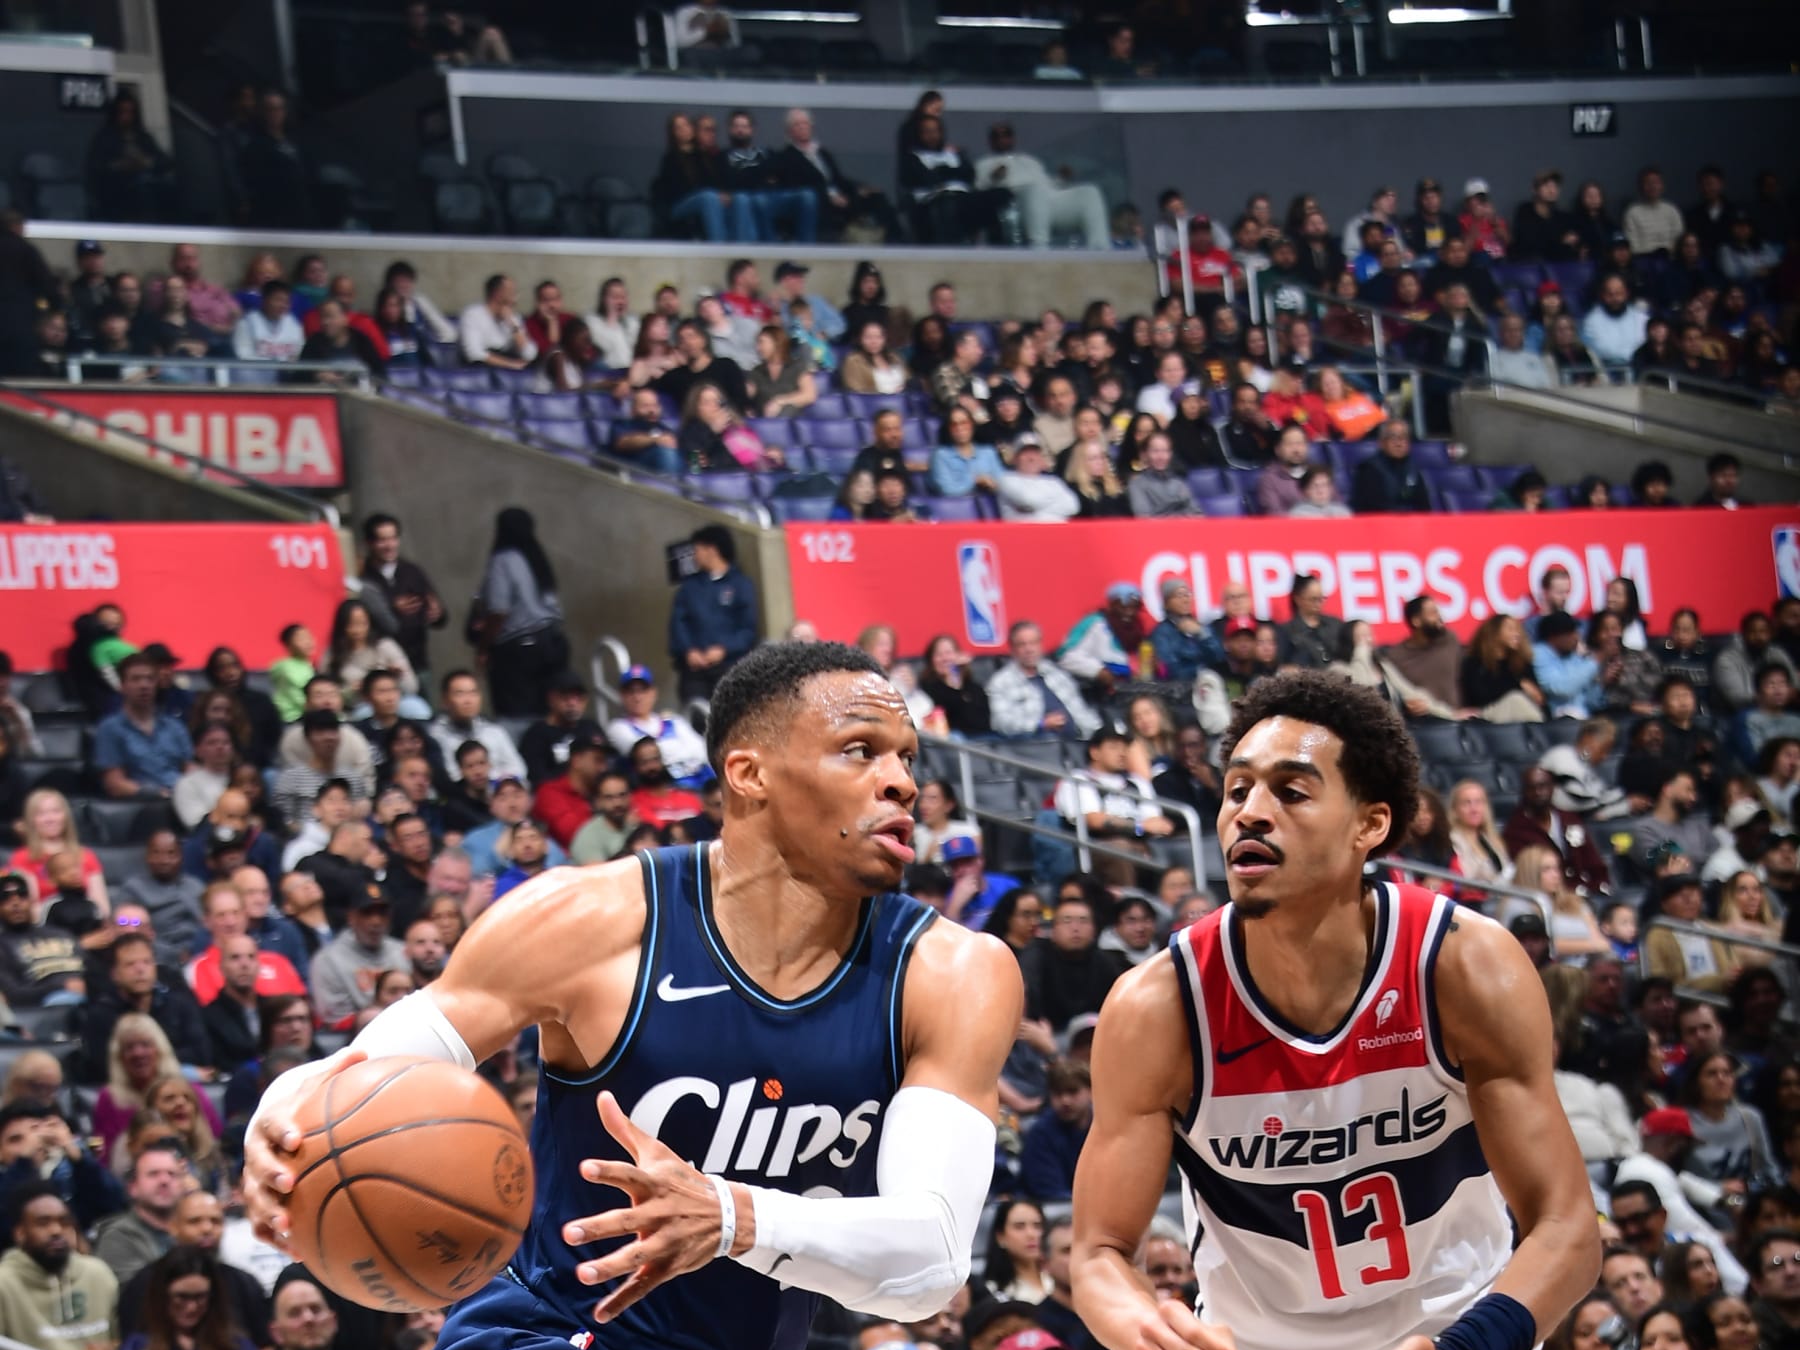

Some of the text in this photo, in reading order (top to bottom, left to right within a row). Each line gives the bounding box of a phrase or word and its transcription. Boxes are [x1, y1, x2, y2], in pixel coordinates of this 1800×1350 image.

[30, 407, 336, 476] SHIBA
[270, 534, 328, 569] 101
[802, 531, 855, 563] 102
[1357, 1026, 1424, 1051] Robinhood
[629, 1076, 880, 1178] Clips
[1208, 1086, 1449, 1169] wizards
[1292, 1171, 1411, 1300] 13
